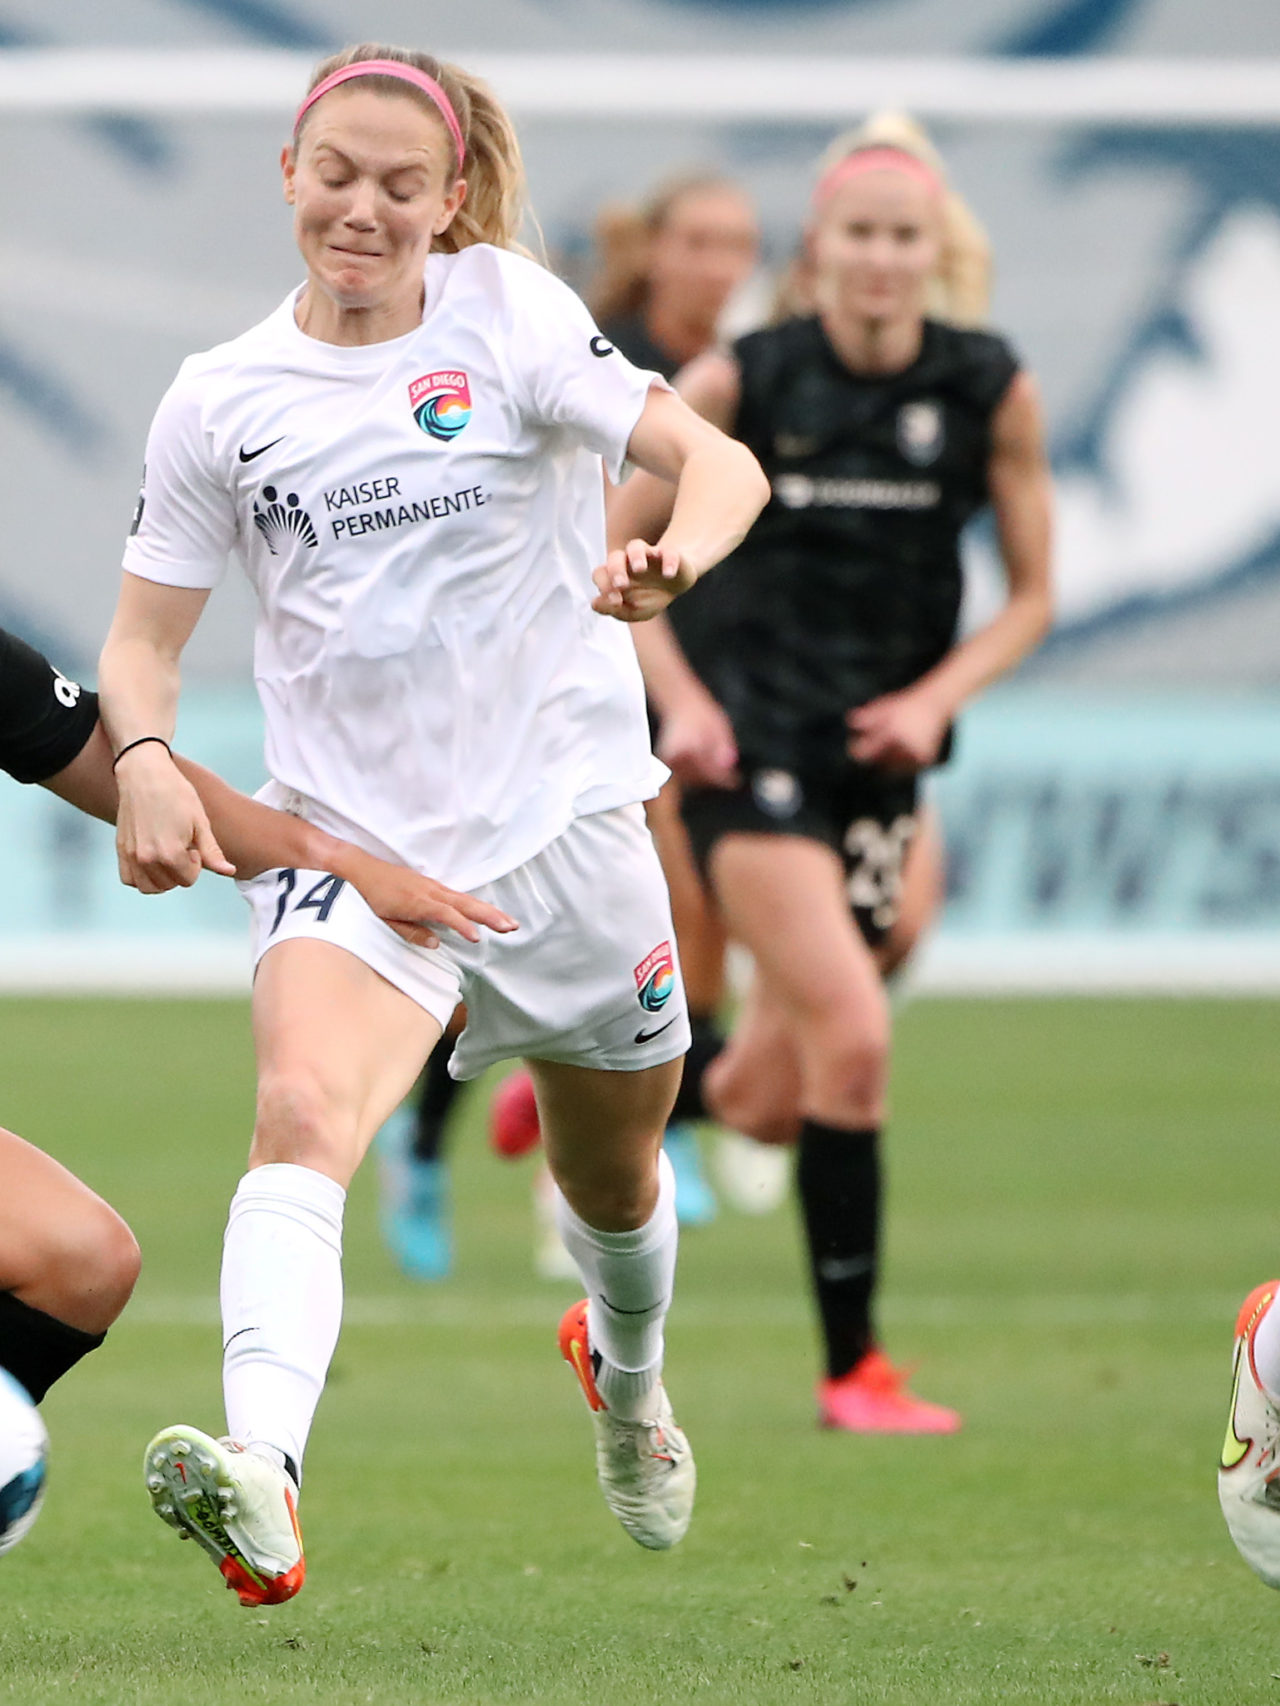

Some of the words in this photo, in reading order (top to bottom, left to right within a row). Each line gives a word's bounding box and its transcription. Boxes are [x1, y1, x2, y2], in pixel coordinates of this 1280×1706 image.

[411, 377, 431, 399] SAN
[431, 374, 466, 389] DIEGO
[324, 477, 401, 512] KAISER
[332, 485, 486, 540] PERMANENTE
